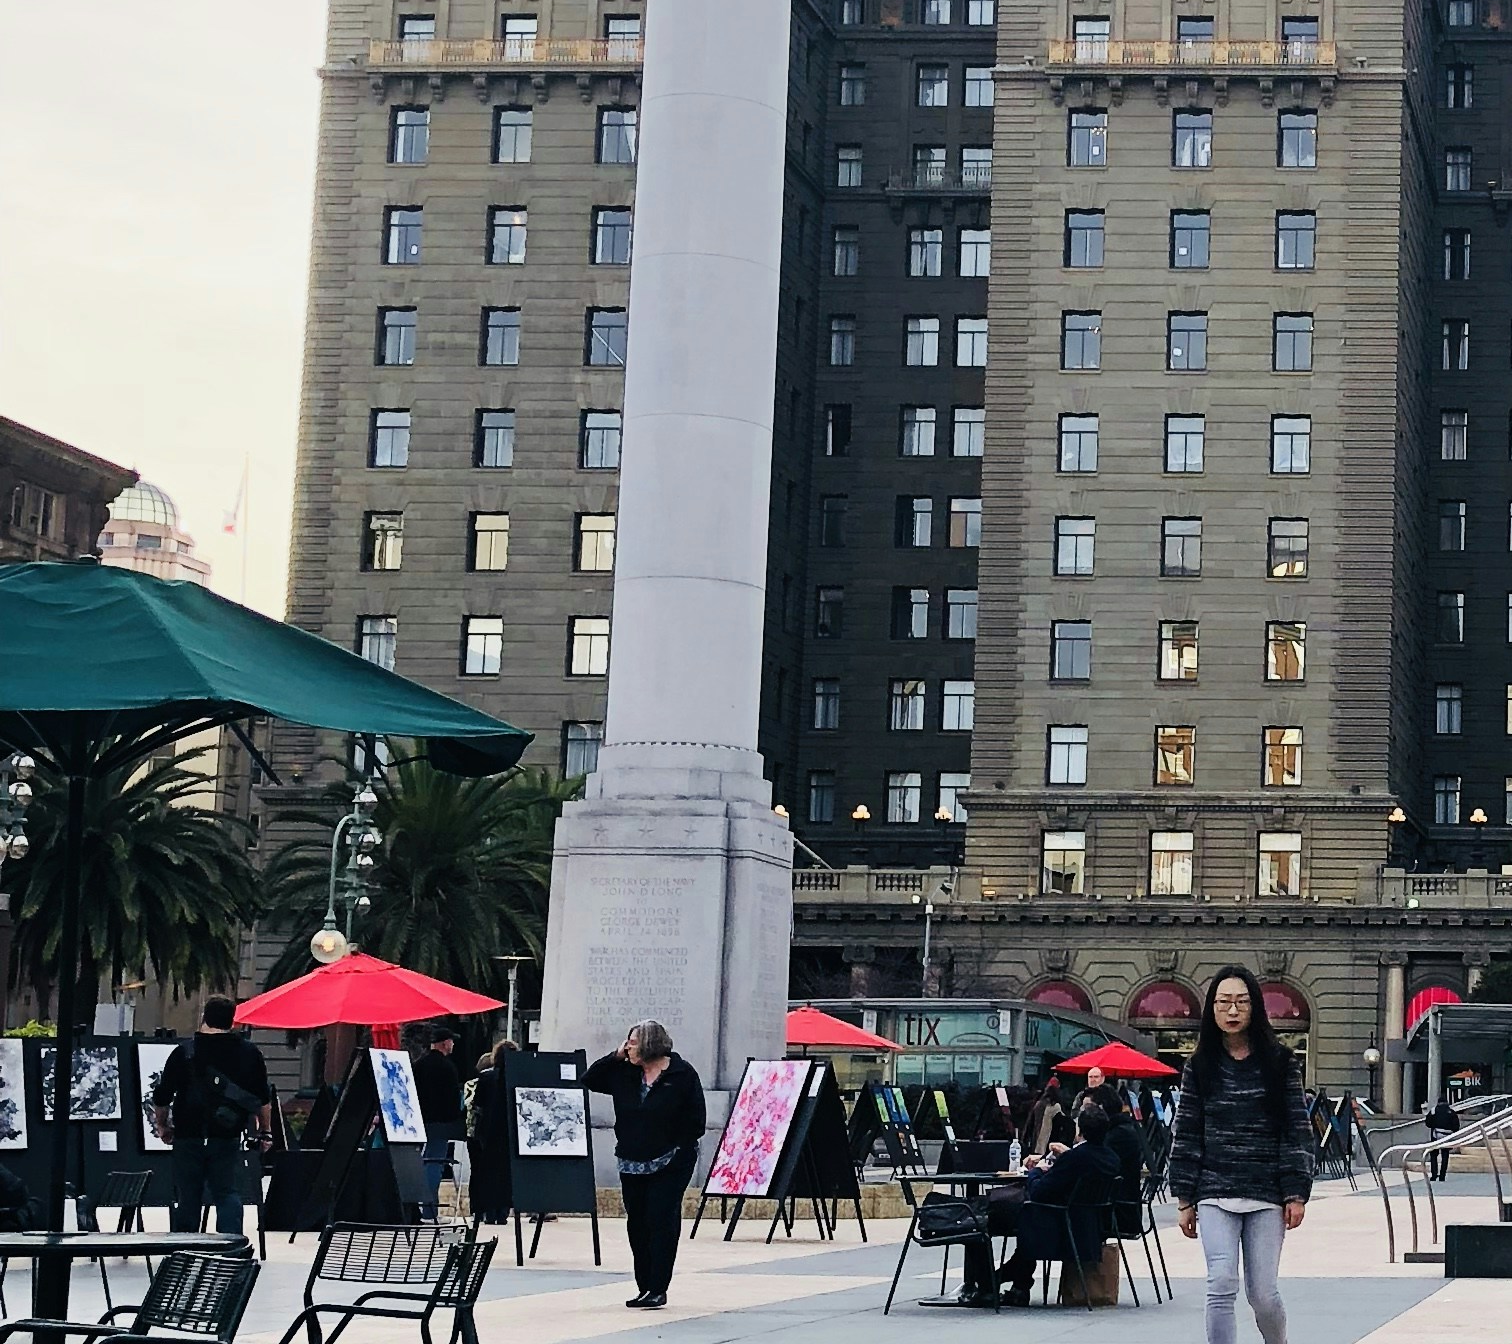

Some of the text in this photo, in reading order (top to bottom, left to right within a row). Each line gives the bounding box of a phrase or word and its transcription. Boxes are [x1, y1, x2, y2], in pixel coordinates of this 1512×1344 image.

[602, 887, 636, 896] JOHN
[651, 887, 682, 896] LONG
[601, 907, 681, 916] COMMODORE
[600, 917, 680, 926] GEORGE DEWEY
[600, 927, 633, 936] APRIL
[653, 957, 688, 966] UNITED
[626, 967, 650, 976] AND
[587, 977, 636, 986] PROCEED
[639, 977, 652, 986] AT
[586, 986, 601, 995] TO
[904, 1012, 941, 1046] tix
